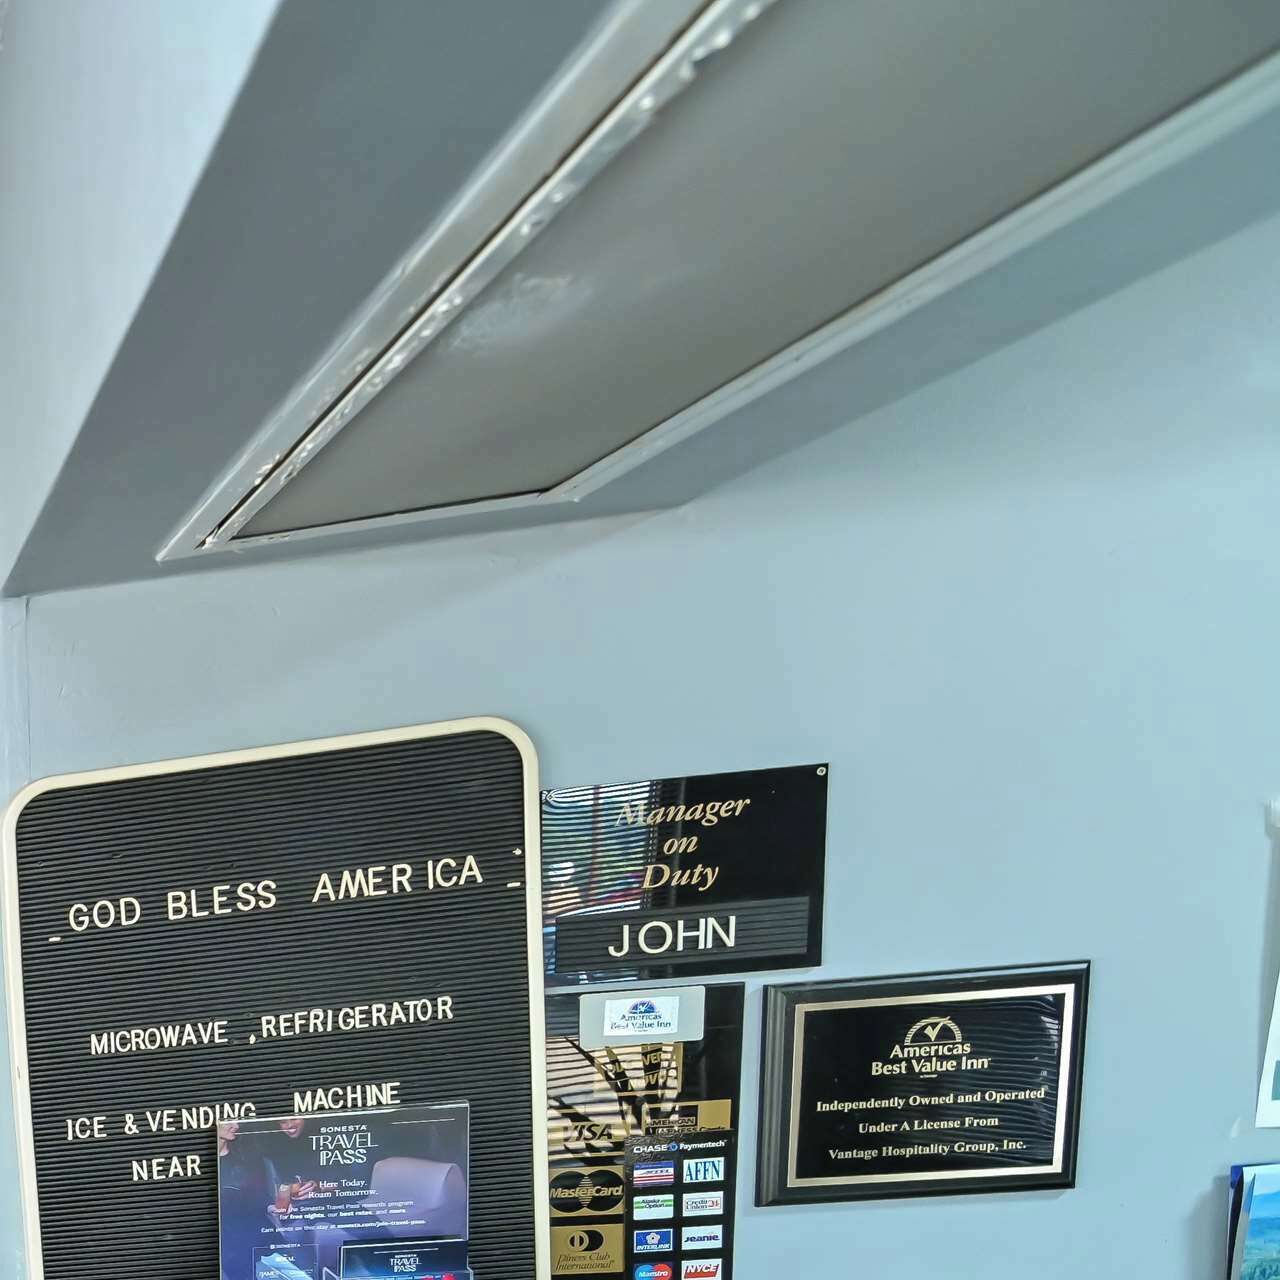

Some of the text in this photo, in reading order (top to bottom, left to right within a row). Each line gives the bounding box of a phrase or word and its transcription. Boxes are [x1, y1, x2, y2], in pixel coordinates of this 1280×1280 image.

[615, 798, 751, 827] Manager
[663, 835, 699, 855] on
[640, 863, 720, 892] Duty
[68, 854, 484, 931] GOD BLESS AMERICA
[607, 915, 737, 958] JOHN
[631, 1021, 655, 1029] Value
[90, 1020, 229, 1056] MICROWAVE
[890, 1041, 971, 1059] Americas
[871, 1058, 989, 1076] Best Value Inn
[816, 1087, 1046, 1112] Independently Owned and Operated
[65, 1081, 401, 1141] ICE & VENDING MACHINE
[320, 1124, 368, 1133] SONESTA
[858, 1116, 999, 1134] Under A License From
[308, 1132, 379, 1151] TRAVEL
[633, 1140, 727, 1154] CHASE Paymentech
[828, 1139, 1027, 1162] Vantage Hospitality Group, Inc.
[319, 1149, 368, 1166] PASS
[131, 1155, 202, 1182] NEAR
[685, 1161, 721, 1182] AFFN
[319, 1178, 368, 1189] Here Today.
[549, 1185, 624, 1198] MasterCard
[308, 1188, 379, 1199] Roam Tomorrow.
[389, 1256, 423, 1266] TRAVEL
[589, 1252, 611, 1261] Club
[393, 1265, 417, 1273] PASS
[639, 1270, 669, 1278] Maestro
